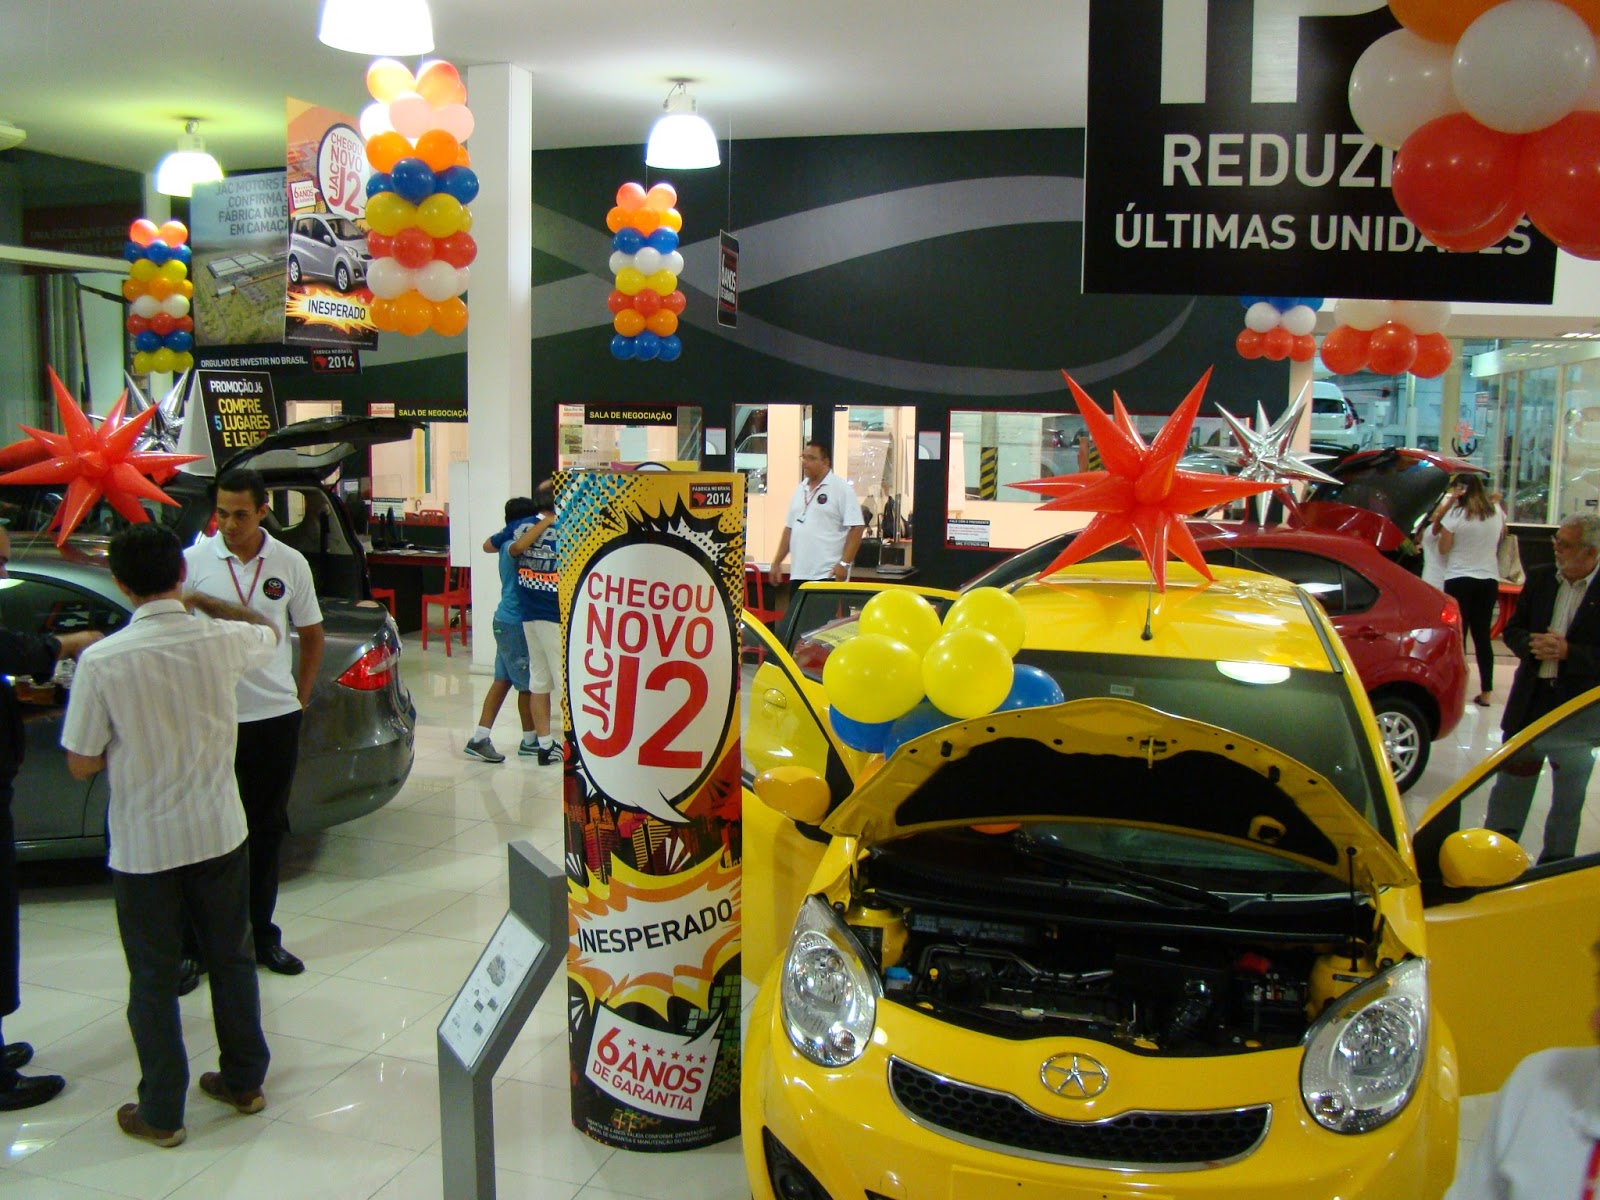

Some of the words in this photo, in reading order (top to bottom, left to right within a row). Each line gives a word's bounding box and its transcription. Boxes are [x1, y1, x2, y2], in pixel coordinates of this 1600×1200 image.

[331, 132, 362, 155] CHEGOU
[331, 145, 363, 173] NOVO
[1163, 133, 1392, 187] REDUZI
[216, 182, 234, 196] JAC
[236, 177, 279, 193] MOTORS
[328, 163, 339, 196] JAC
[228, 192, 283, 208] CONFIRMA
[328, 166, 361, 216] J2
[218, 207, 262, 223] FÁBRICA
[263, 207, 279, 218] NA
[230, 223, 245, 235] EM
[1115, 202, 1296, 250] ÚLTIMAS
[1310, 214, 1531, 255] UNIDS
[308, 299, 366, 321] INESPERADO
[201, 359, 230, 368] ORGULHO
[231, 359, 240, 367] DE
[240, 357, 270, 366] INVESTIR
[270, 357, 280, 365] NO
[327, 355, 355, 369] 2014
[210, 378, 253, 396] PROMOÇÃO
[254, 382, 263, 394] J6
[218, 398, 263, 414] COMPRE
[398, 409, 417, 417] SALA
[428, 408, 468, 418] NEGOCIAÇÃ
[589, 411, 609, 419] SALA
[611, 411, 621, 419] DE
[622, 411, 672, 421] NEGOCIAÇÃO
[214, 415, 222, 431] 5
[222, 415, 271, 431] LUGARES
[223, 432, 232, 447] E
[233, 431, 260, 447] LEVE
[706, 492, 731, 505] 2014
[587, 572, 714, 613] CHEGOU
[587, 603, 713, 659] NOVO
[582, 648, 614, 733] JAC
[581, 655, 708, 769] J2
[578, 898, 732, 953] INESPERADO
[597, 1027, 621, 1066] 6
[618, 1051, 704, 1095] ANOS
[593, 1058, 610, 1083] DE
[611, 1073, 693, 1111] GARANTIA
